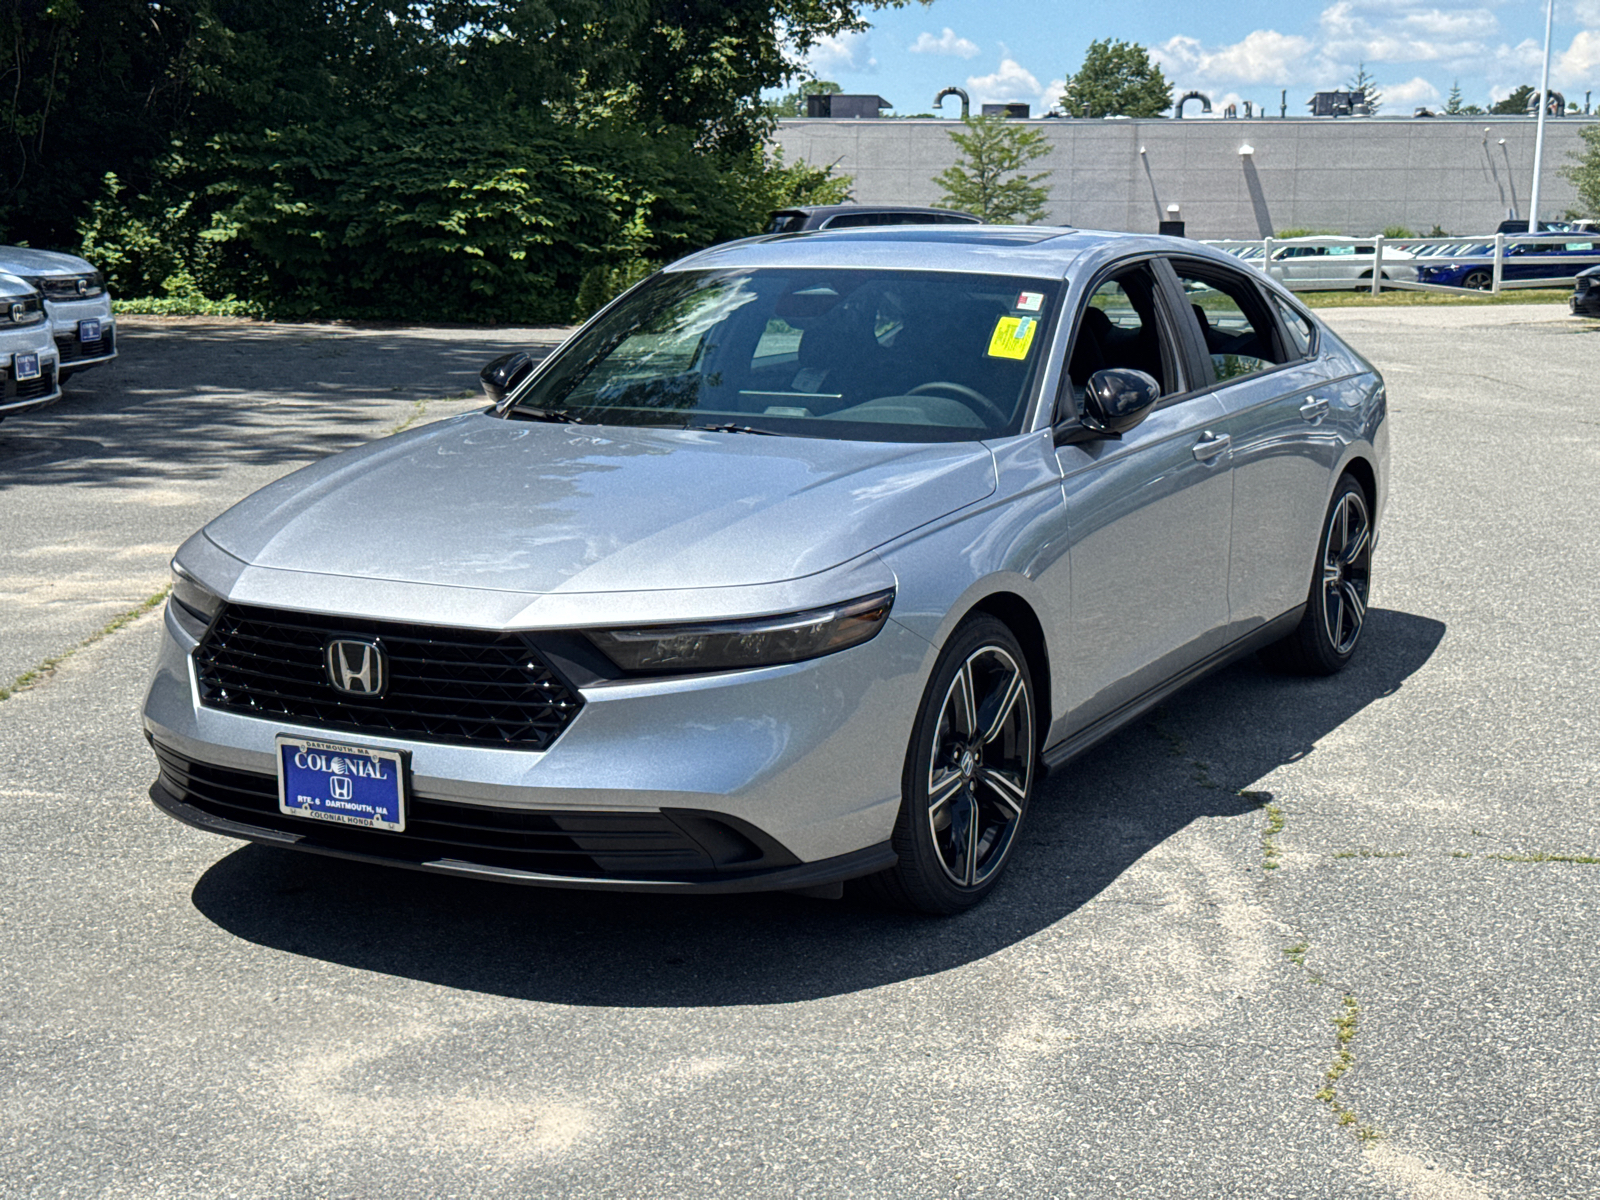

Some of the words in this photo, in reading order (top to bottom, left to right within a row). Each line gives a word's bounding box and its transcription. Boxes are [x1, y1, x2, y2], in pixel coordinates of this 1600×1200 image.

[294, 752, 388, 780] COLONIAL
[297, 795, 314, 804] RTE.
[325, 799, 375, 814] DARTMOUTH,
[375, 806, 389, 816] MA
[310, 811, 346, 823] COLONIAL
[347, 816, 374, 826] HONDA
